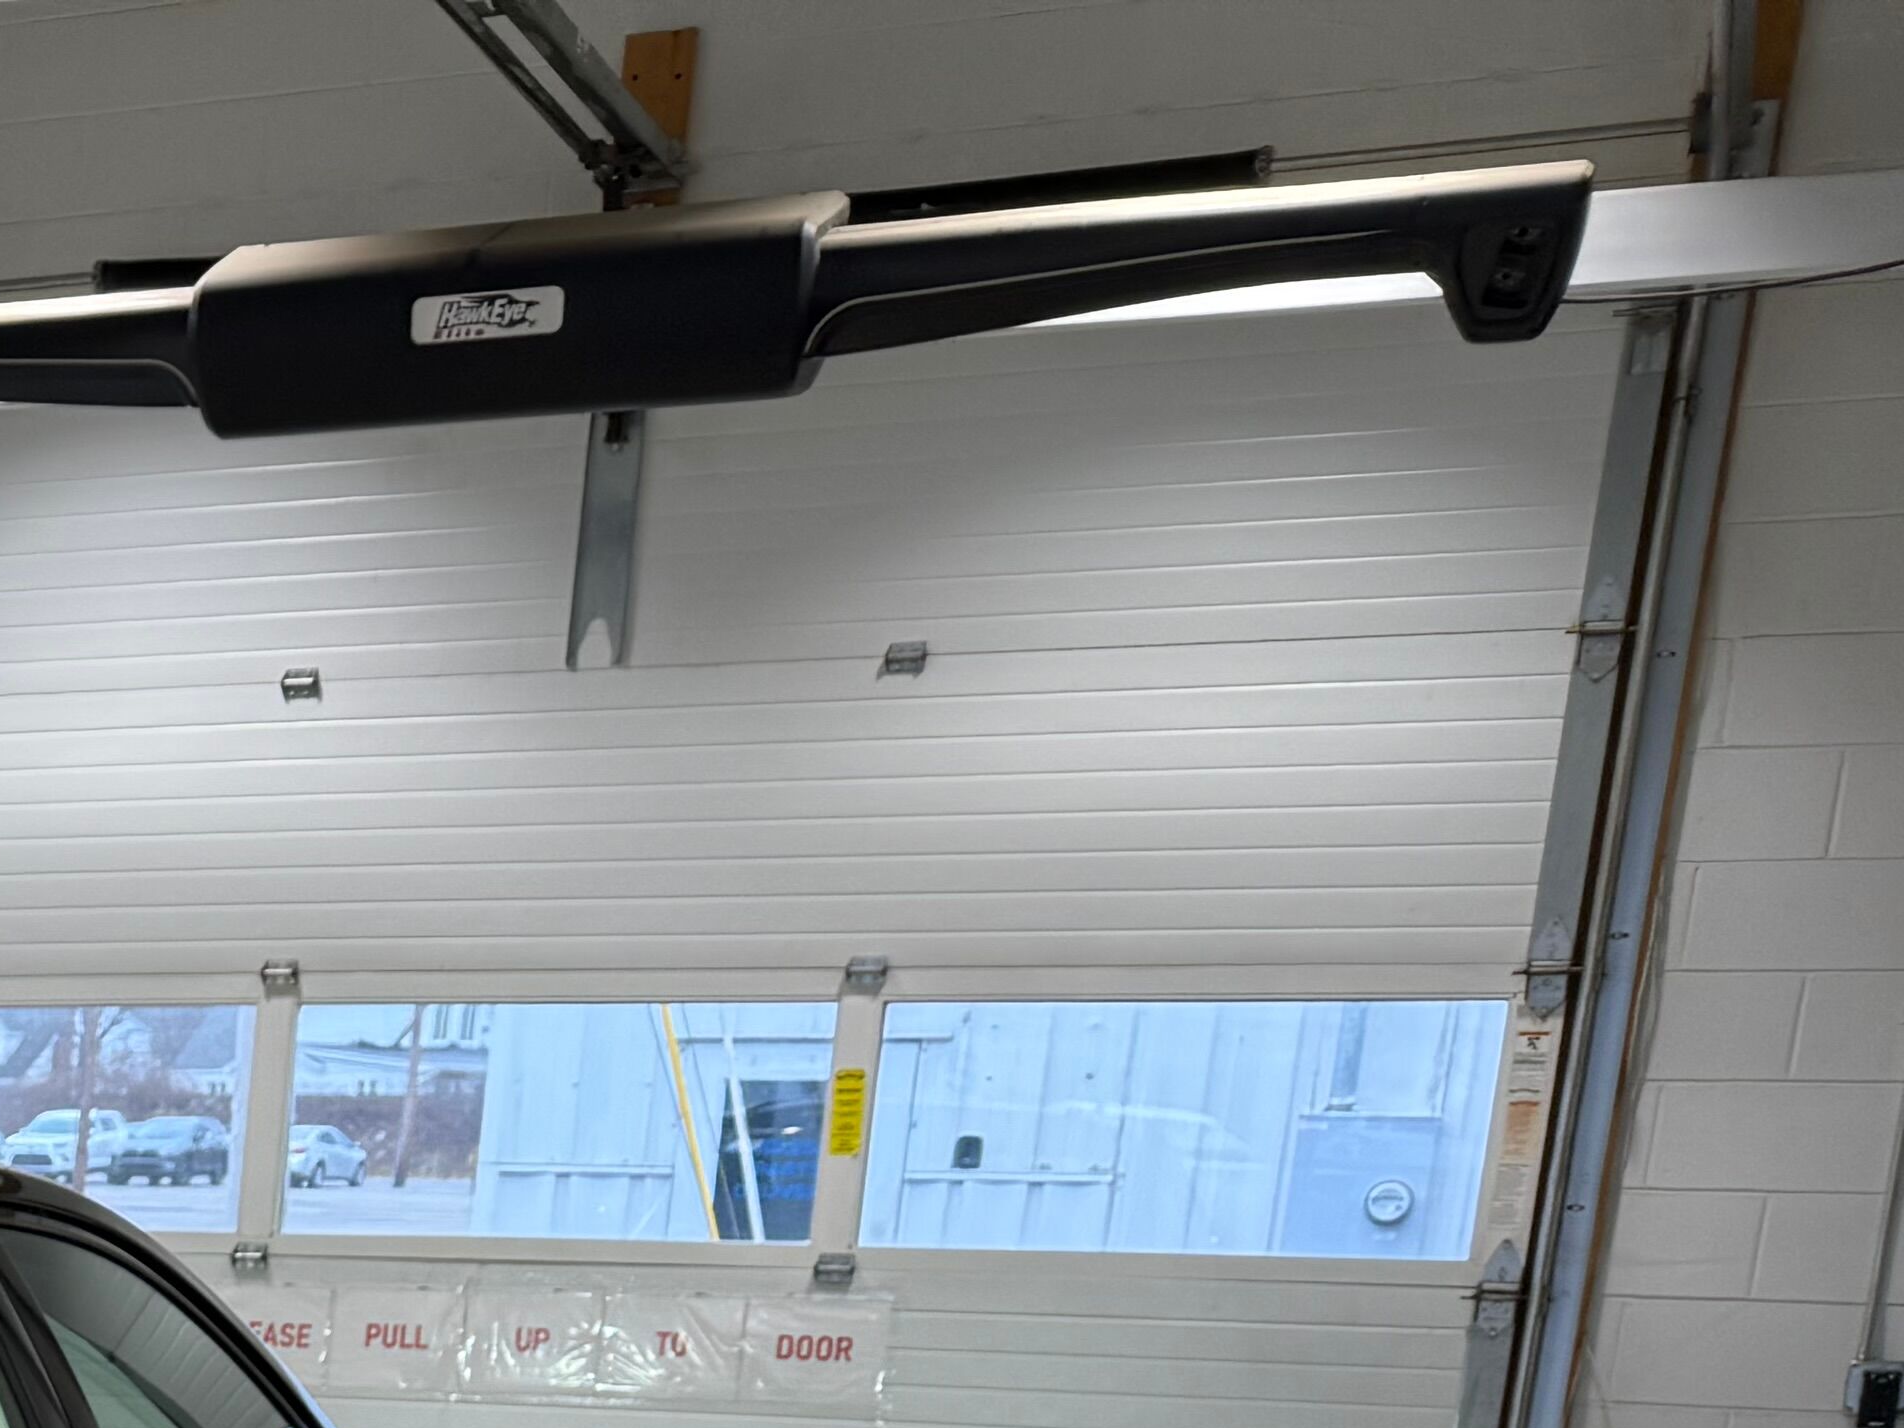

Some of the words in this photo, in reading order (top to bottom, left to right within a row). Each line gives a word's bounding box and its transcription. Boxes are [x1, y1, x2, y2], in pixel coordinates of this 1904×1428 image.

[439, 298, 527, 326] HawkEye
[364, 1322, 429, 1350] PULL
[514, 1326, 550, 1353] UP
[775, 1335, 854, 1363] DOOR
